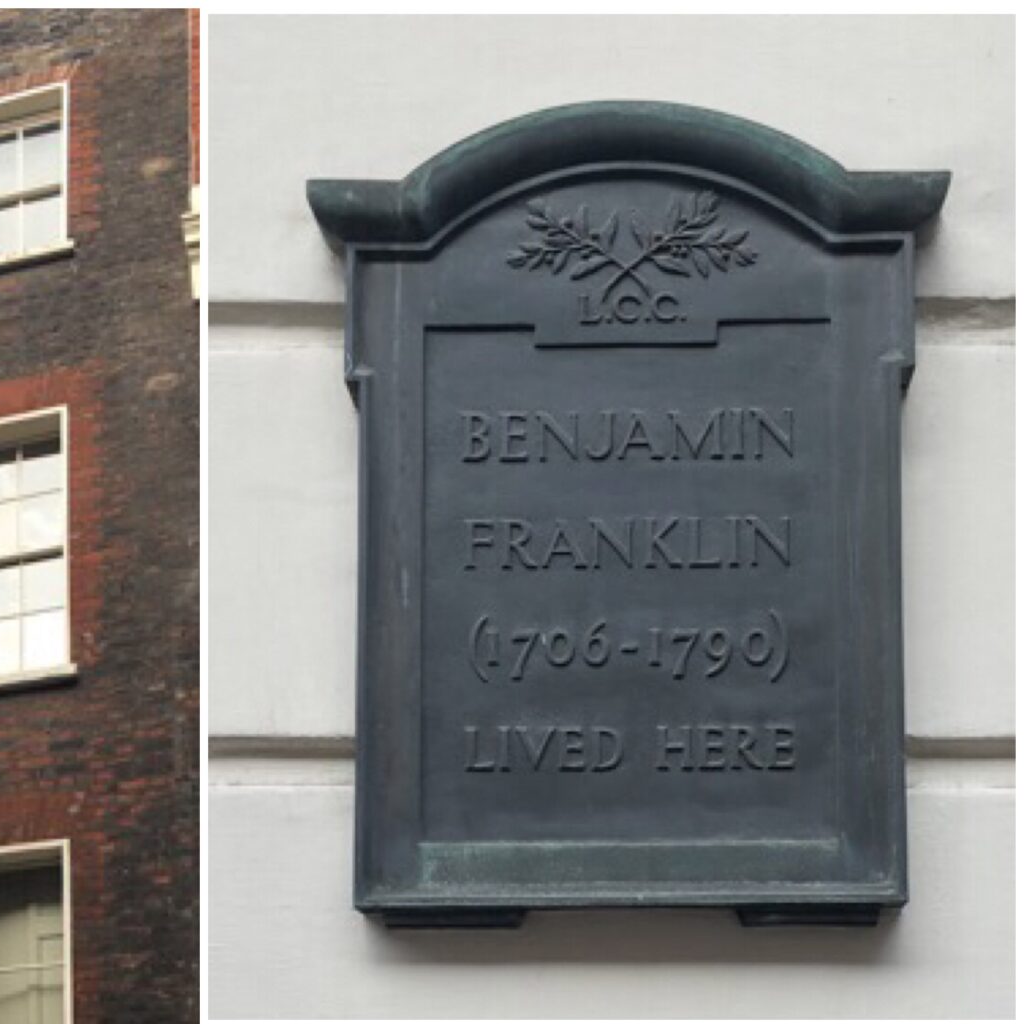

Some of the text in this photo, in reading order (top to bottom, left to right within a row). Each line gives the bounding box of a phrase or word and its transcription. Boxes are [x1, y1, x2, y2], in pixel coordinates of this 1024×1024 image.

[579, 295, 688, 325] L.C.C.
[460, 407, 795, 464] BENJAMIN
[463, 515, 792, 572] FRANKLIN
[468, 608, 790, 683] (1706-1790)
[463, 724, 797, 773] LIVED HERE
